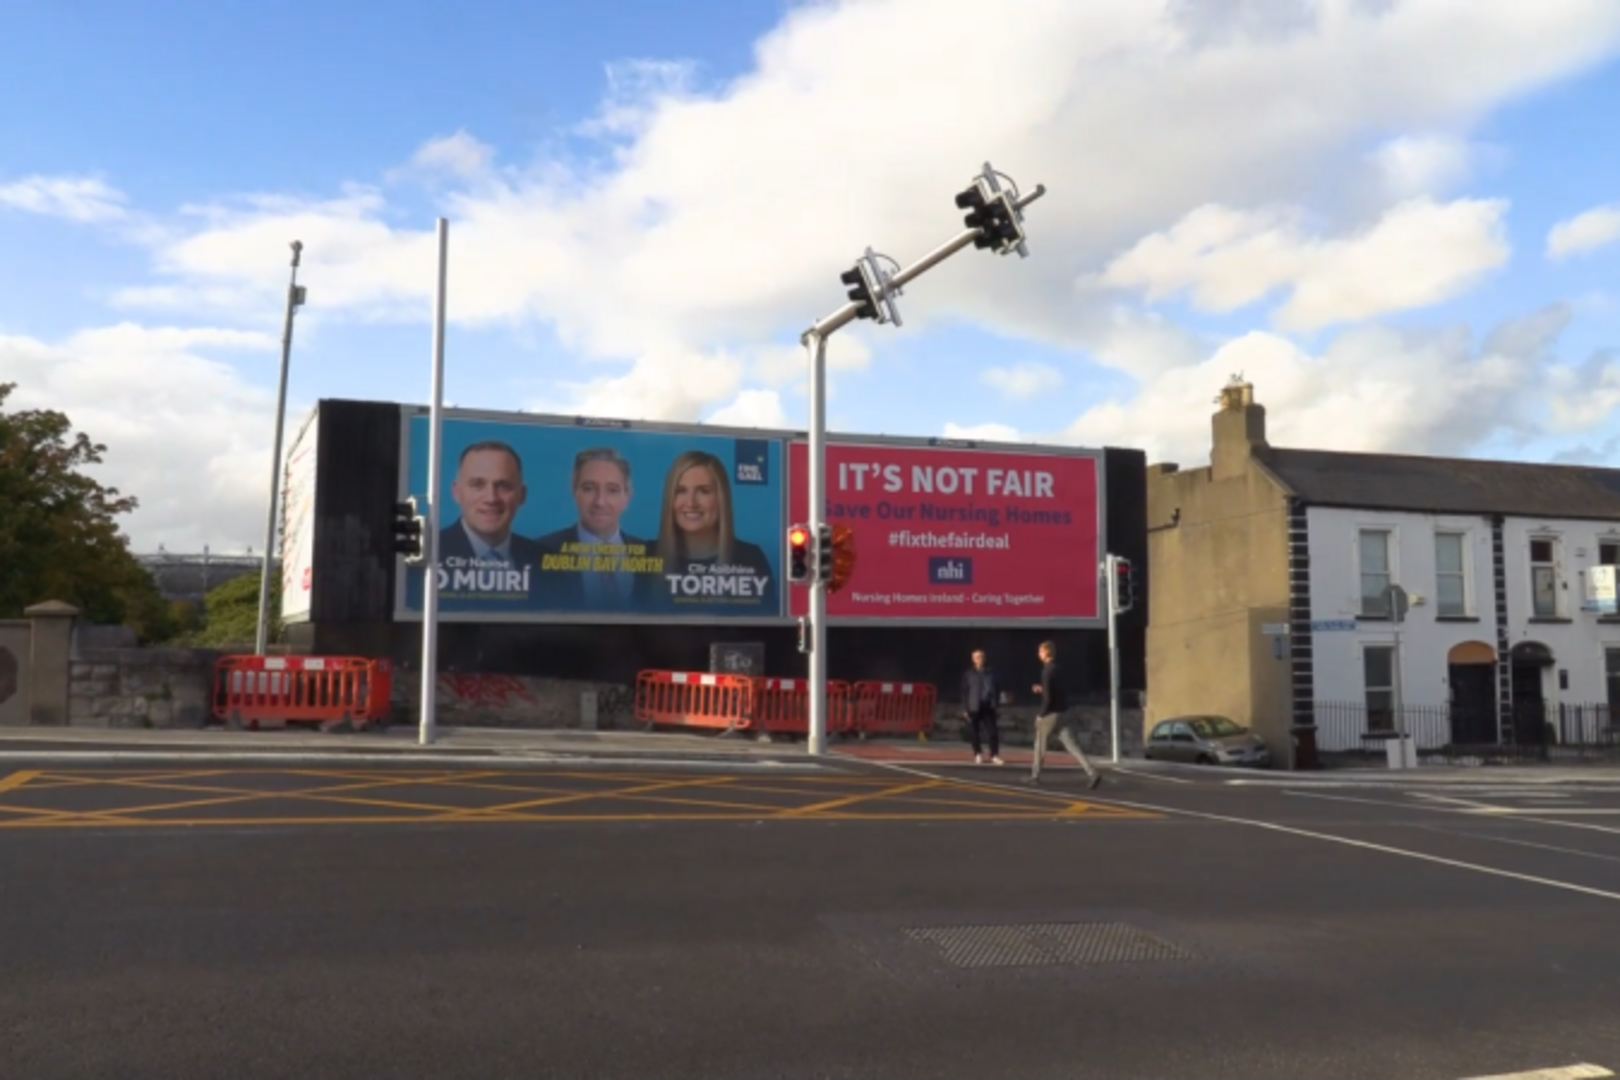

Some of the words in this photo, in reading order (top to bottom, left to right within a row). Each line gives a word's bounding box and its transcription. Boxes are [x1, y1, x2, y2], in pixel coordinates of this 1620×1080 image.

[912, 466, 978, 494] NOT
[987, 469, 1055, 498] FAIR
[876, 502, 914, 519] Our
[920, 503, 1000, 527] Nursing
[1005, 506, 1072, 524] Homes
[888, 530, 1010, 550] #fixthefairdeal
[628, 545, 647, 556] FOR
[542, 554, 591, 571] DUBLIN
[592, 556, 619, 572] BAY
[620, 557, 664, 573] NORTH
[937, 561, 964, 579] nhi
[453, 565, 532, 591] MUIRÍ
[666, 574, 769, 596] TORMEY
[851, 592, 891, 605] Nursing
[893, 593, 927, 604] Homes
[929, 593, 964, 604] Ireland
[972, 593, 1001, 606] Caring
[1004, 594, 1045, 606] Together
